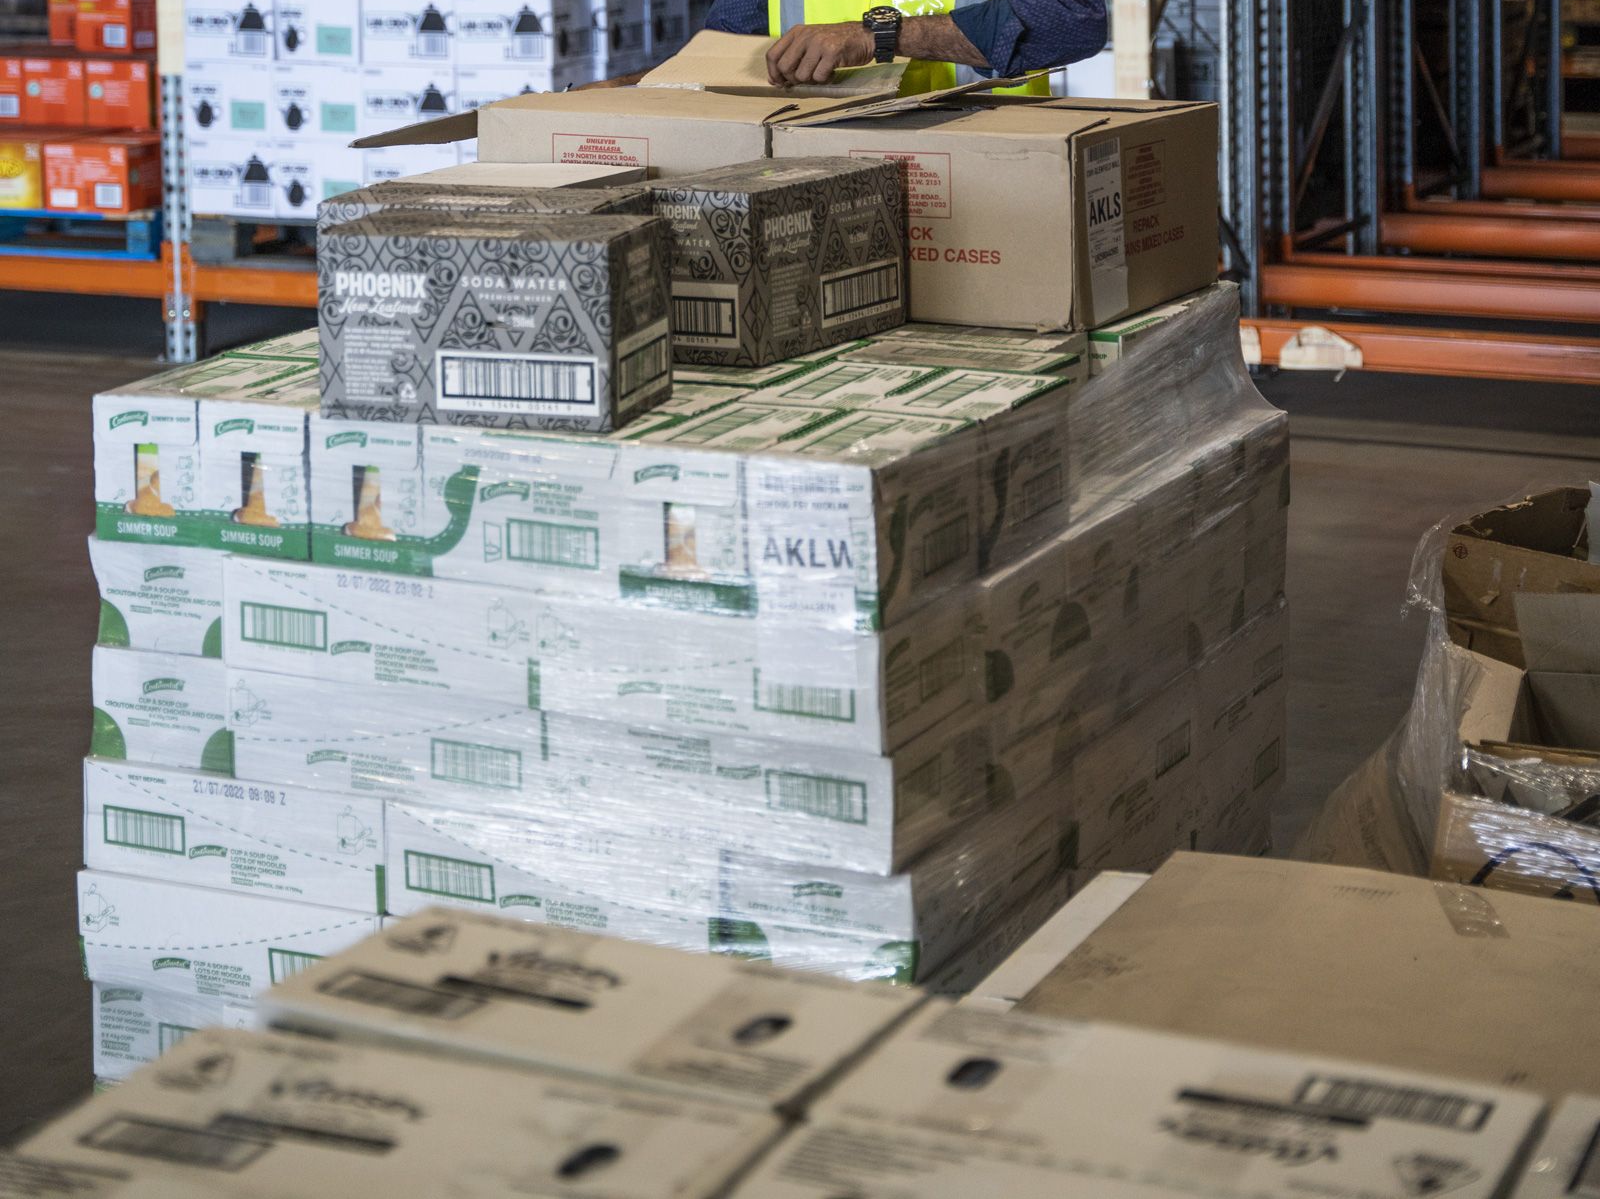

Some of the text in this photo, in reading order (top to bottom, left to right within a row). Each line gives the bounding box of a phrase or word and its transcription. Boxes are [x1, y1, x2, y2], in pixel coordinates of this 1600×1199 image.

[829, 194, 882, 215] SODA WATER
[1089, 191, 1122, 228] AKLS
[677, 238, 711, 248] WATER
[944, 249, 1001, 265] CASES
[461, 276, 567, 291] SODA WATER
[117, 521, 178, 537] SIMMER SOUP
[220, 529, 283, 548] SIMMER SOUP
[334, 544, 399, 564] SIMMER SOUP
[193, 778, 244, 799] 21/07/2022
